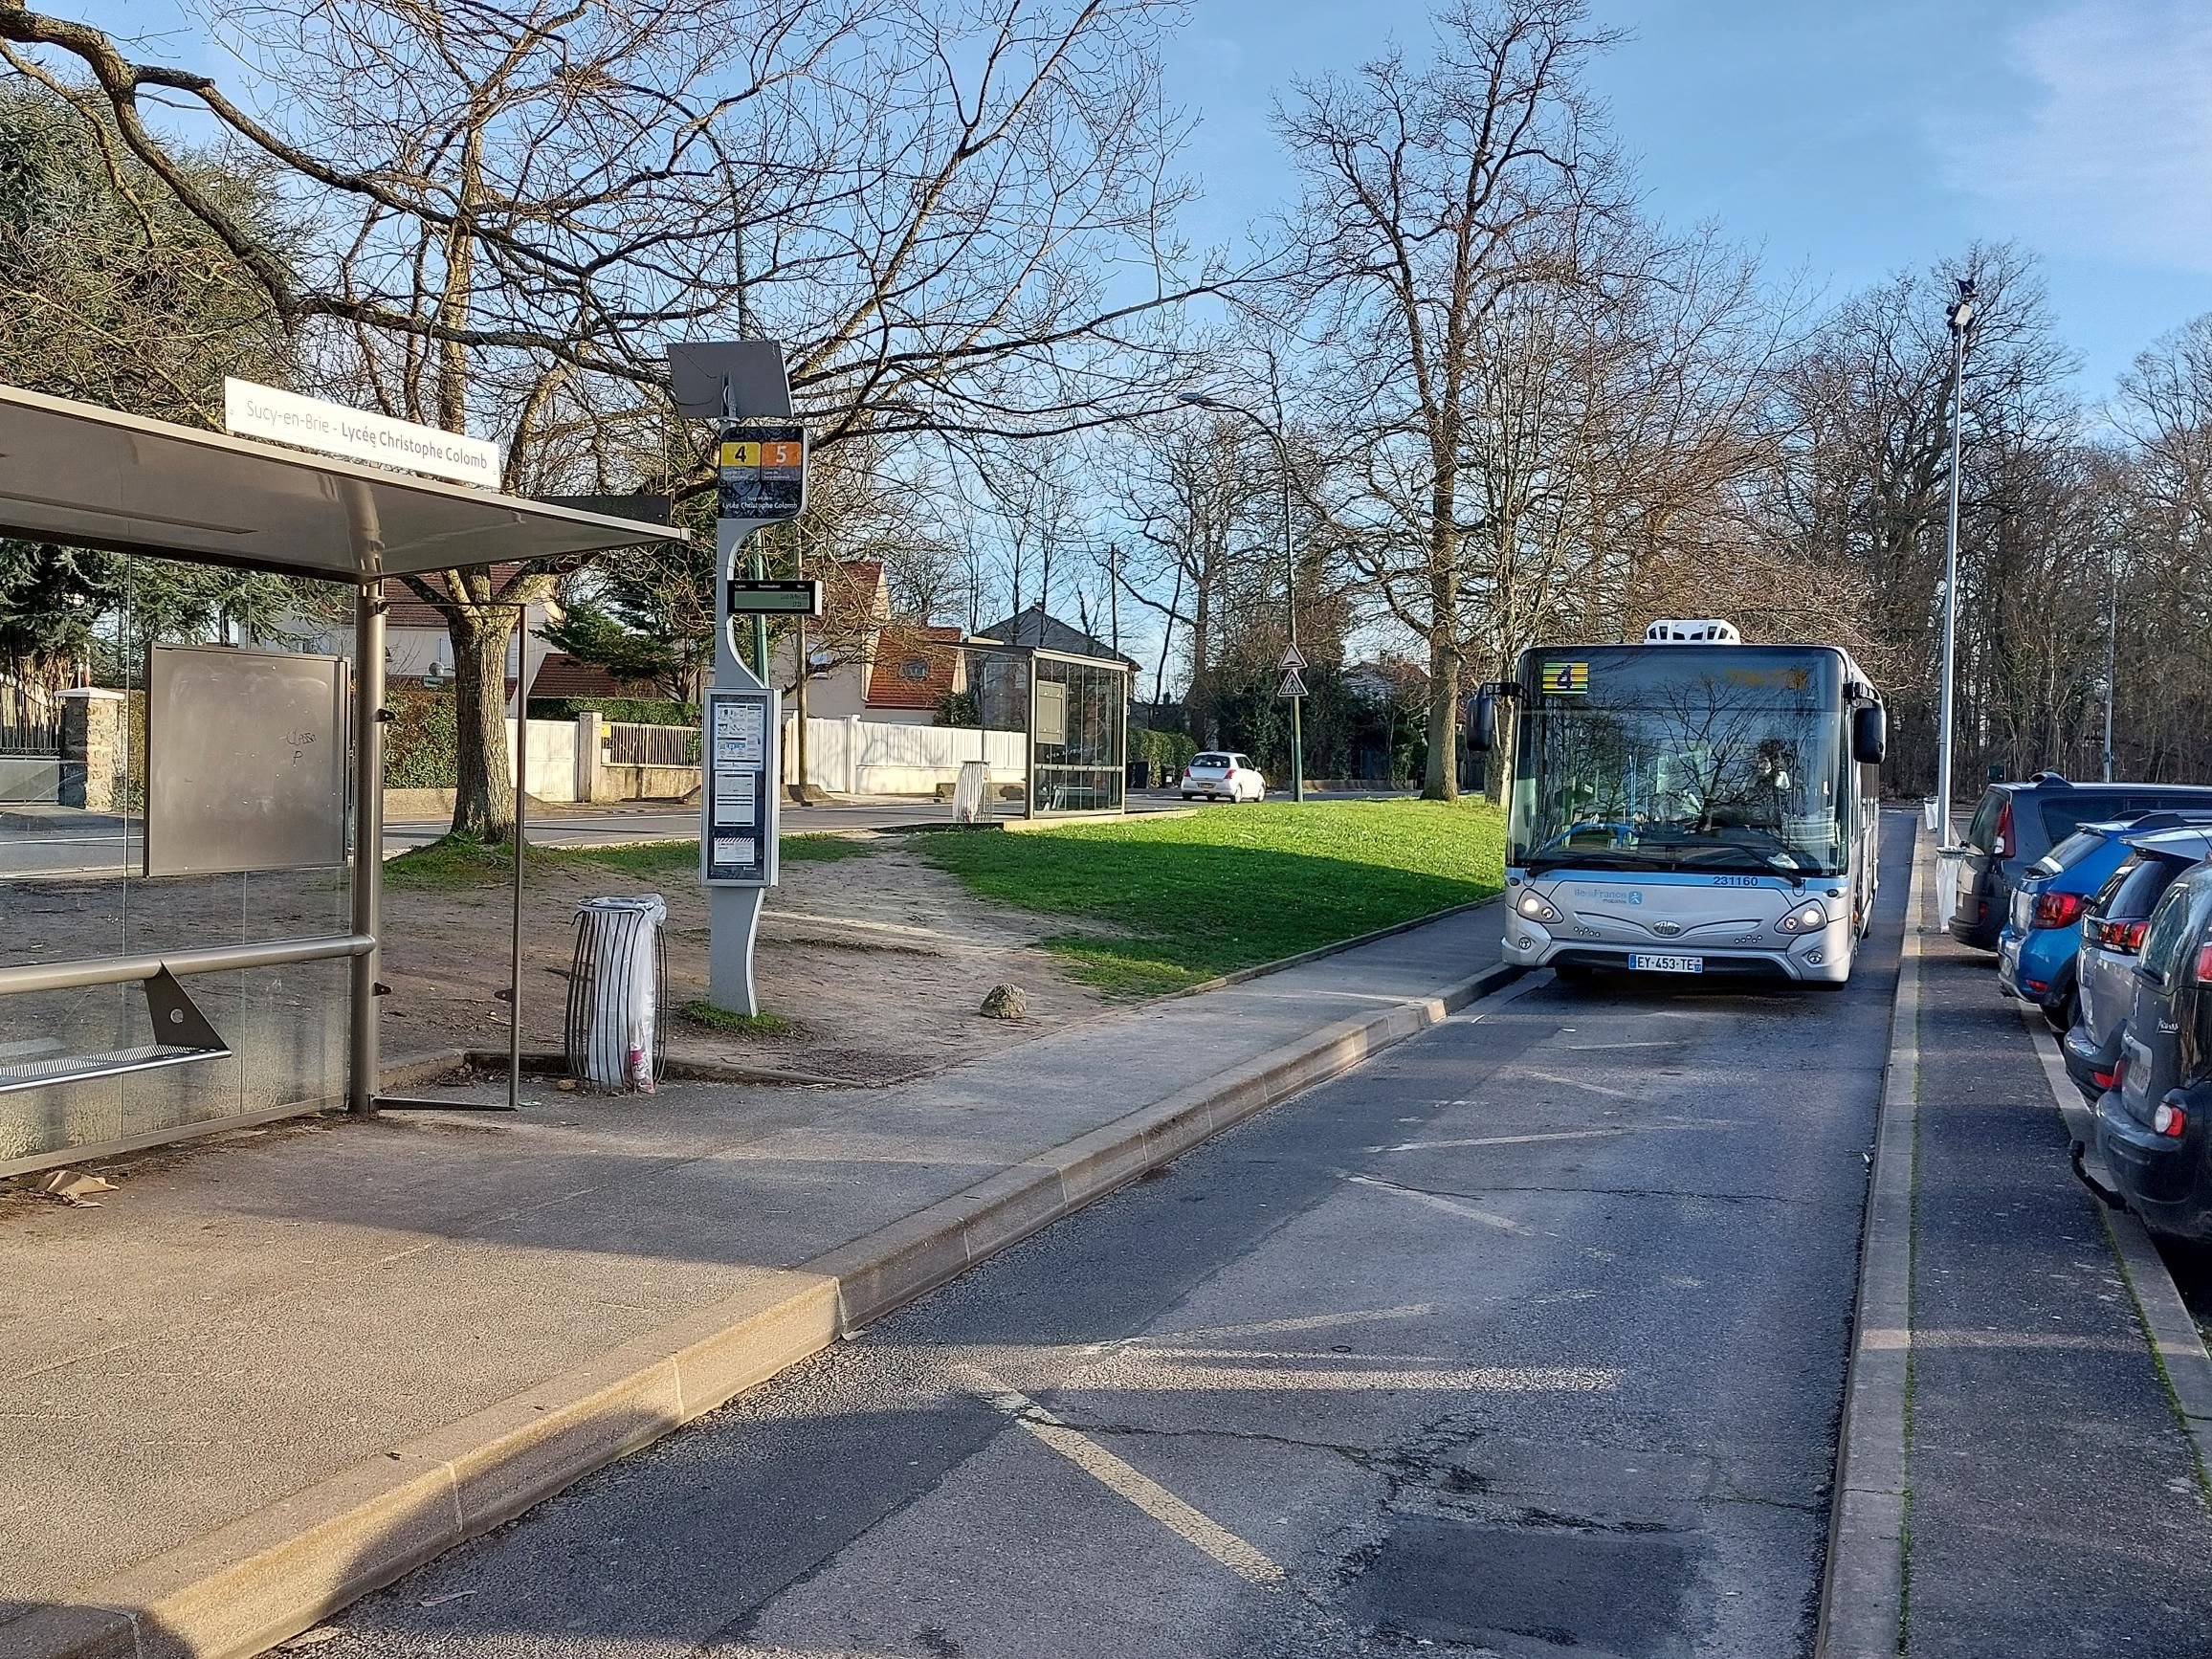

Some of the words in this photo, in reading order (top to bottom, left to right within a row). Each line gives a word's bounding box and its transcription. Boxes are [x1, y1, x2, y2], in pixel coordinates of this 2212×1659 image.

[247, 400, 329, 433] Sucy-en-Brie
[341, 421, 377, 443] Lycée
[379, 431, 444, 459] Christophe
[445, 447, 488, 469] Colomb
[734, 445, 747, 463] 4
[775, 445, 787, 464] 5
[1556, 664, 1574, 689] 4
[1714, 875, 1759, 887] 231160
[1637, 957, 1694, 971] EY-453-TE
